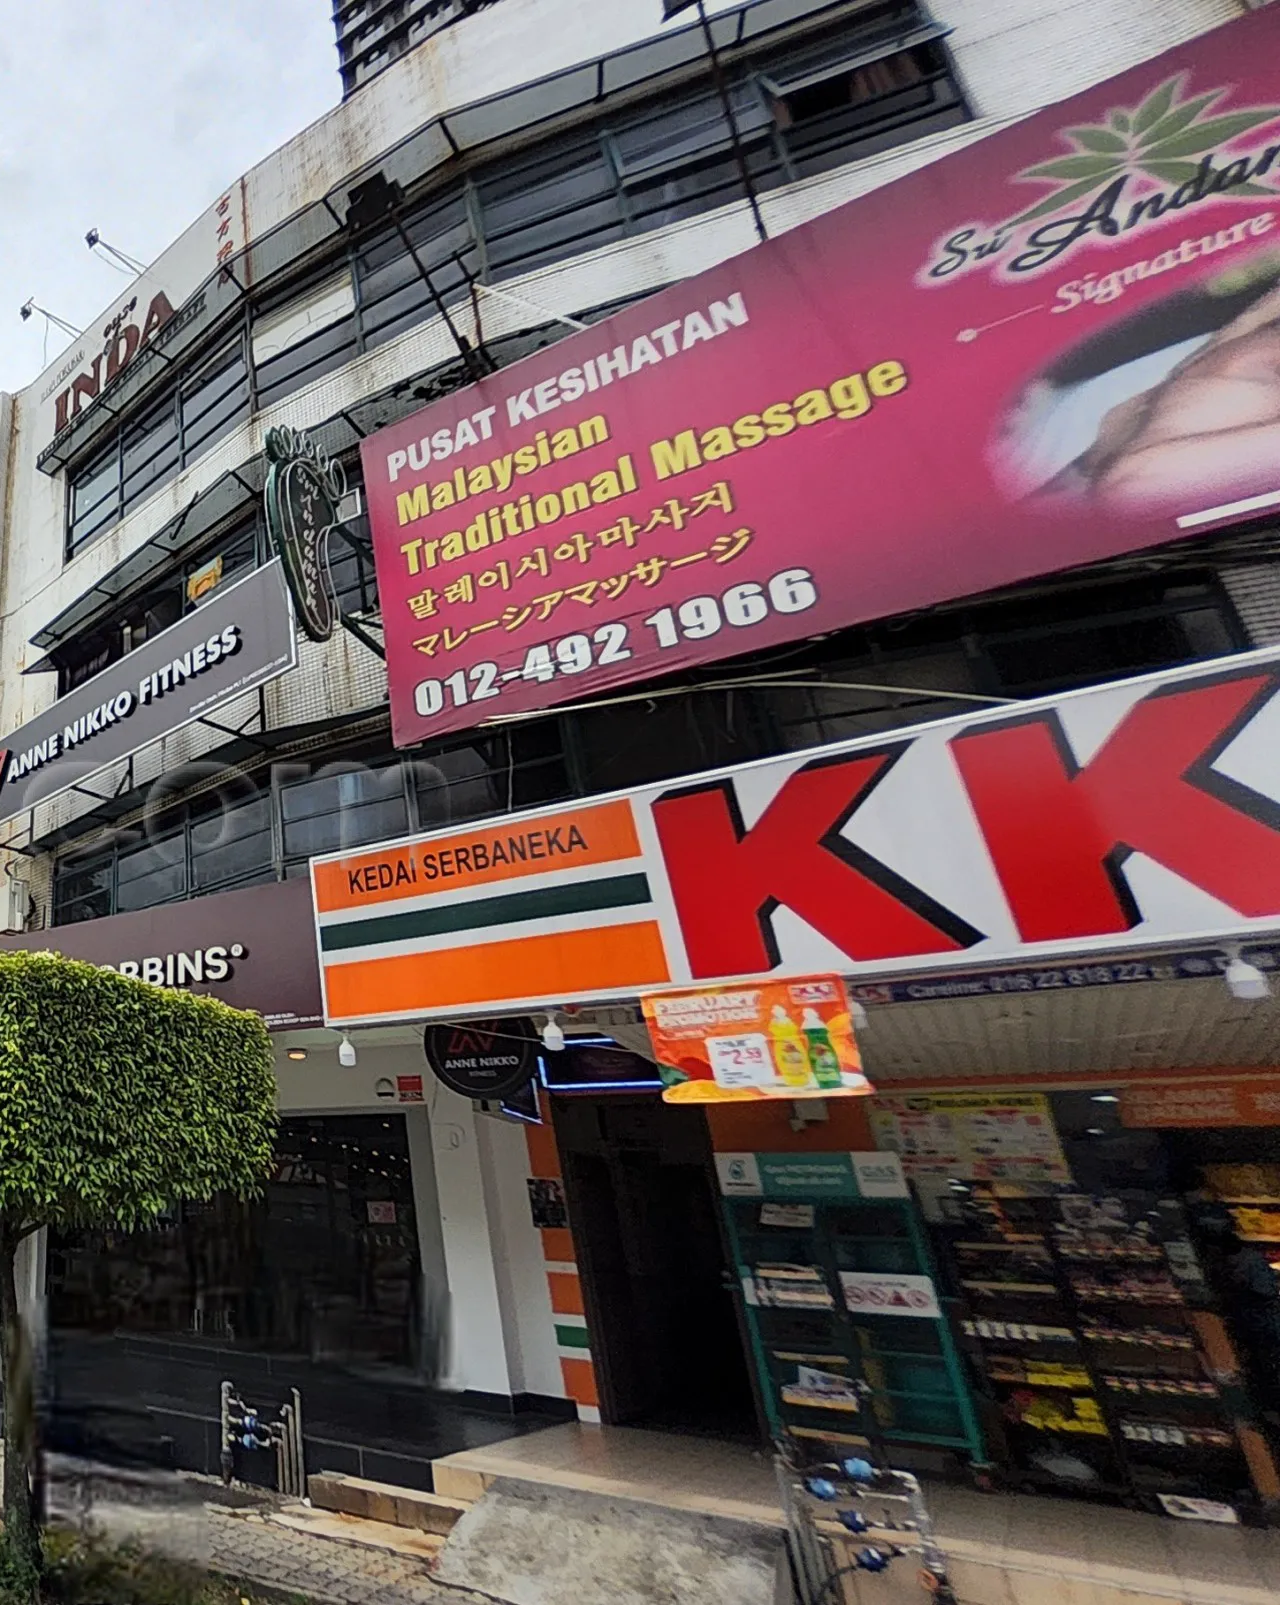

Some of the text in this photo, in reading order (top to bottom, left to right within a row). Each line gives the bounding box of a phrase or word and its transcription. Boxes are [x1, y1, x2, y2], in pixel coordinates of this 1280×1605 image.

[1050, 212, 1276, 314] Signature
[386, 292, 750, 482] PUSAT KESIHATAN
[395, 414, 610, 527] Malaysian
[399, 355, 910, 577] Traditional Massage
[411, 527, 755, 658] マレーシアマッサージ
[413, 568, 819, 718] 012-492 1966
[6, 731, 60, 783] ANNE
[63, 690, 134, 750] NIKKO
[139, 624, 240, 705] FITNESS
[348, 821, 588, 896] KEDAI SERBANEKA
[445, 1055, 519, 1069] ANNE NIKKO
